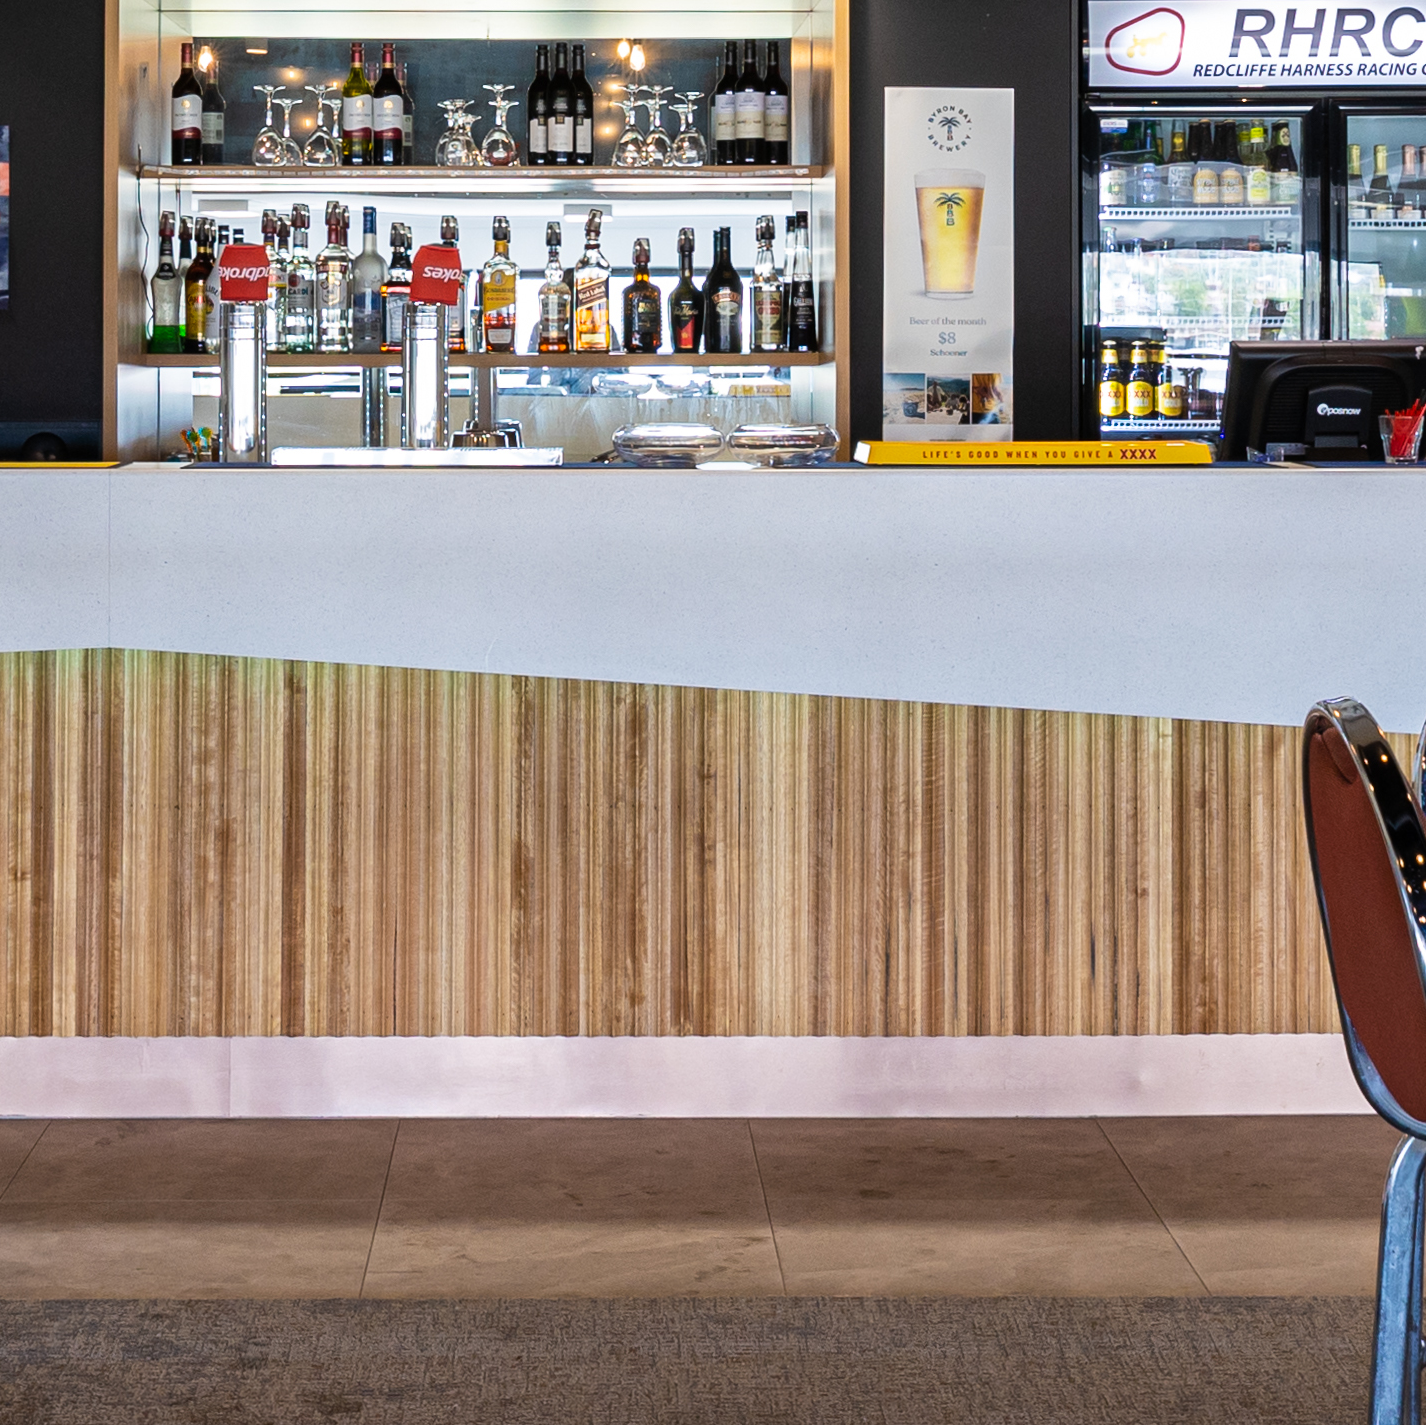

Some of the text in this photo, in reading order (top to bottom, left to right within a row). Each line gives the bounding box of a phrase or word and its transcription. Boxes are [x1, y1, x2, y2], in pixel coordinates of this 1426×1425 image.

[1228, 7, 1426, 58] RHRC
[1193, 63, 1277, 77] REDCLIFFE
[1280, 63, 1354, 76] HARNESS
[1357, 63, 1418, 76] RACING
[927, 105, 972, 124] BYRON BAY
[927, 134, 972, 152] BREWERY
[909, 317, 987, 326] Beer of the month
[938, 332, 957, 345] $8
[930, 349, 968, 357] Schooner
[922, 450, 962, 459] LIFE'S
[968, 451, 999, 459] GOOD
[1005, 451, 1038, 459] WHEN
[1044, 451, 1067, 459] YOU
[1074, 451, 1101, 459] GIVE
[1119, 449, 1157, 460] XXXX
